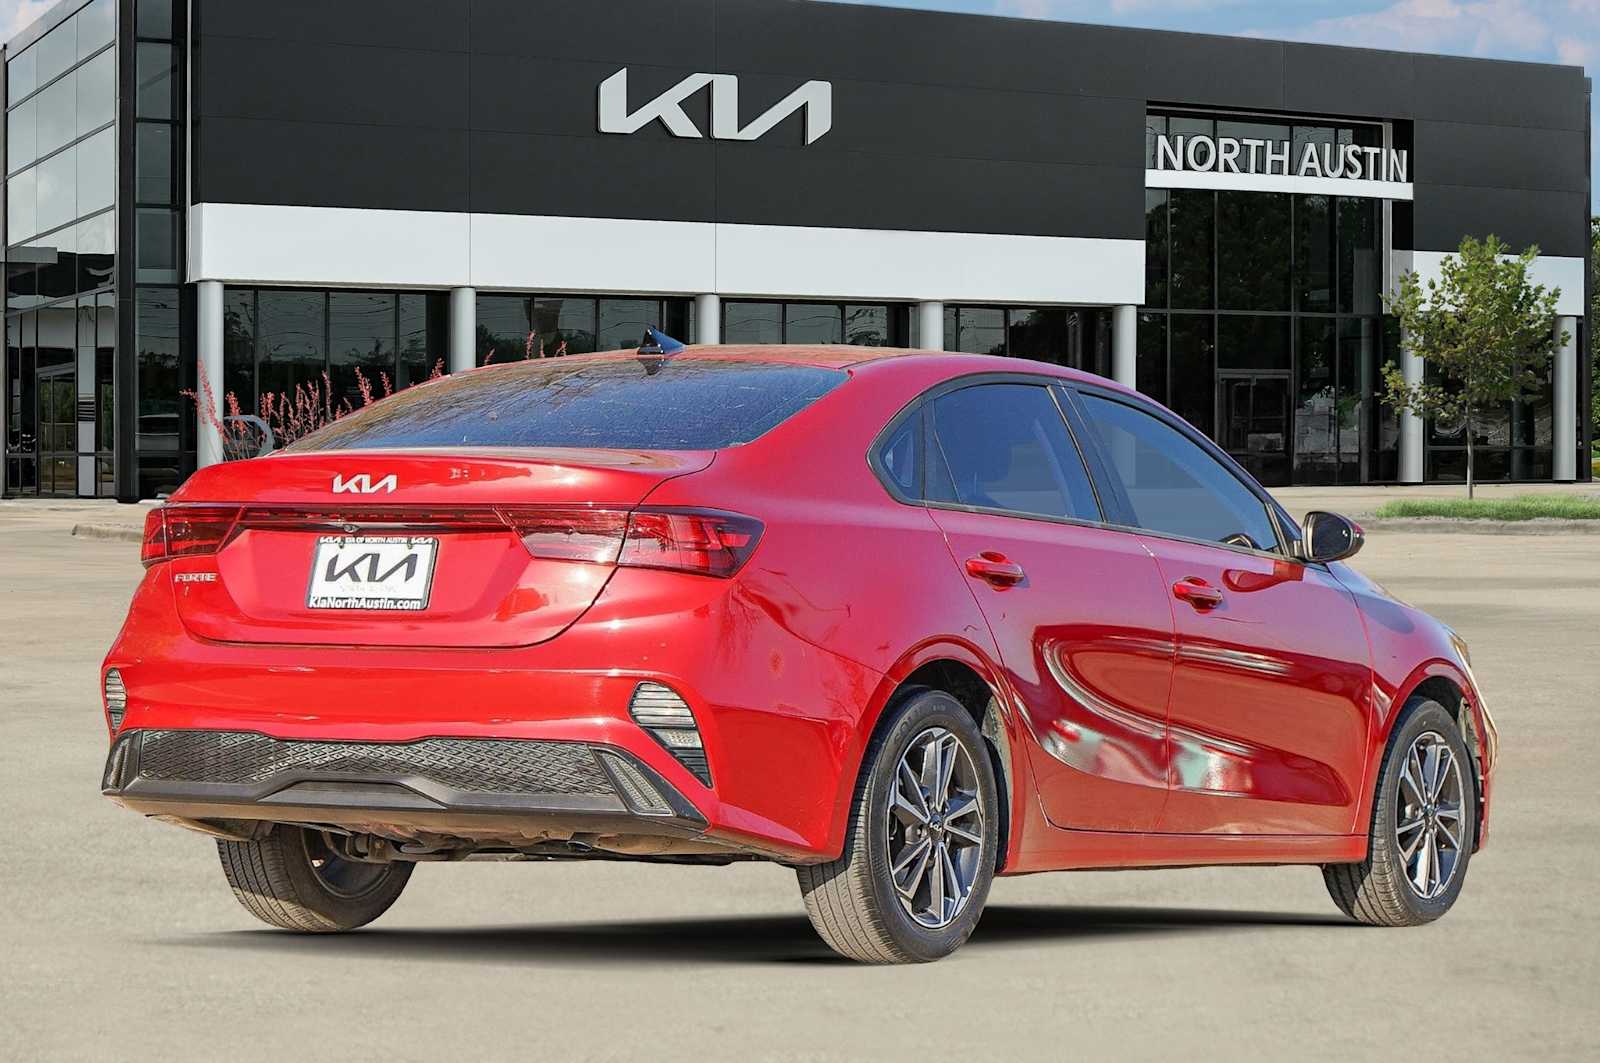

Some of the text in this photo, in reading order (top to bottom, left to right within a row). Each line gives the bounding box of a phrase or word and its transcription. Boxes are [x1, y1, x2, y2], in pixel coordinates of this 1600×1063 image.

[597, 67, 832, 145] KIA
[1156, 134, 1408, 184] NORTH AUSTIN
[332, 474, 398, 494] KIA
[174, 572, 217, 584] FORTE
[325, 553, 418, 583] KIA
